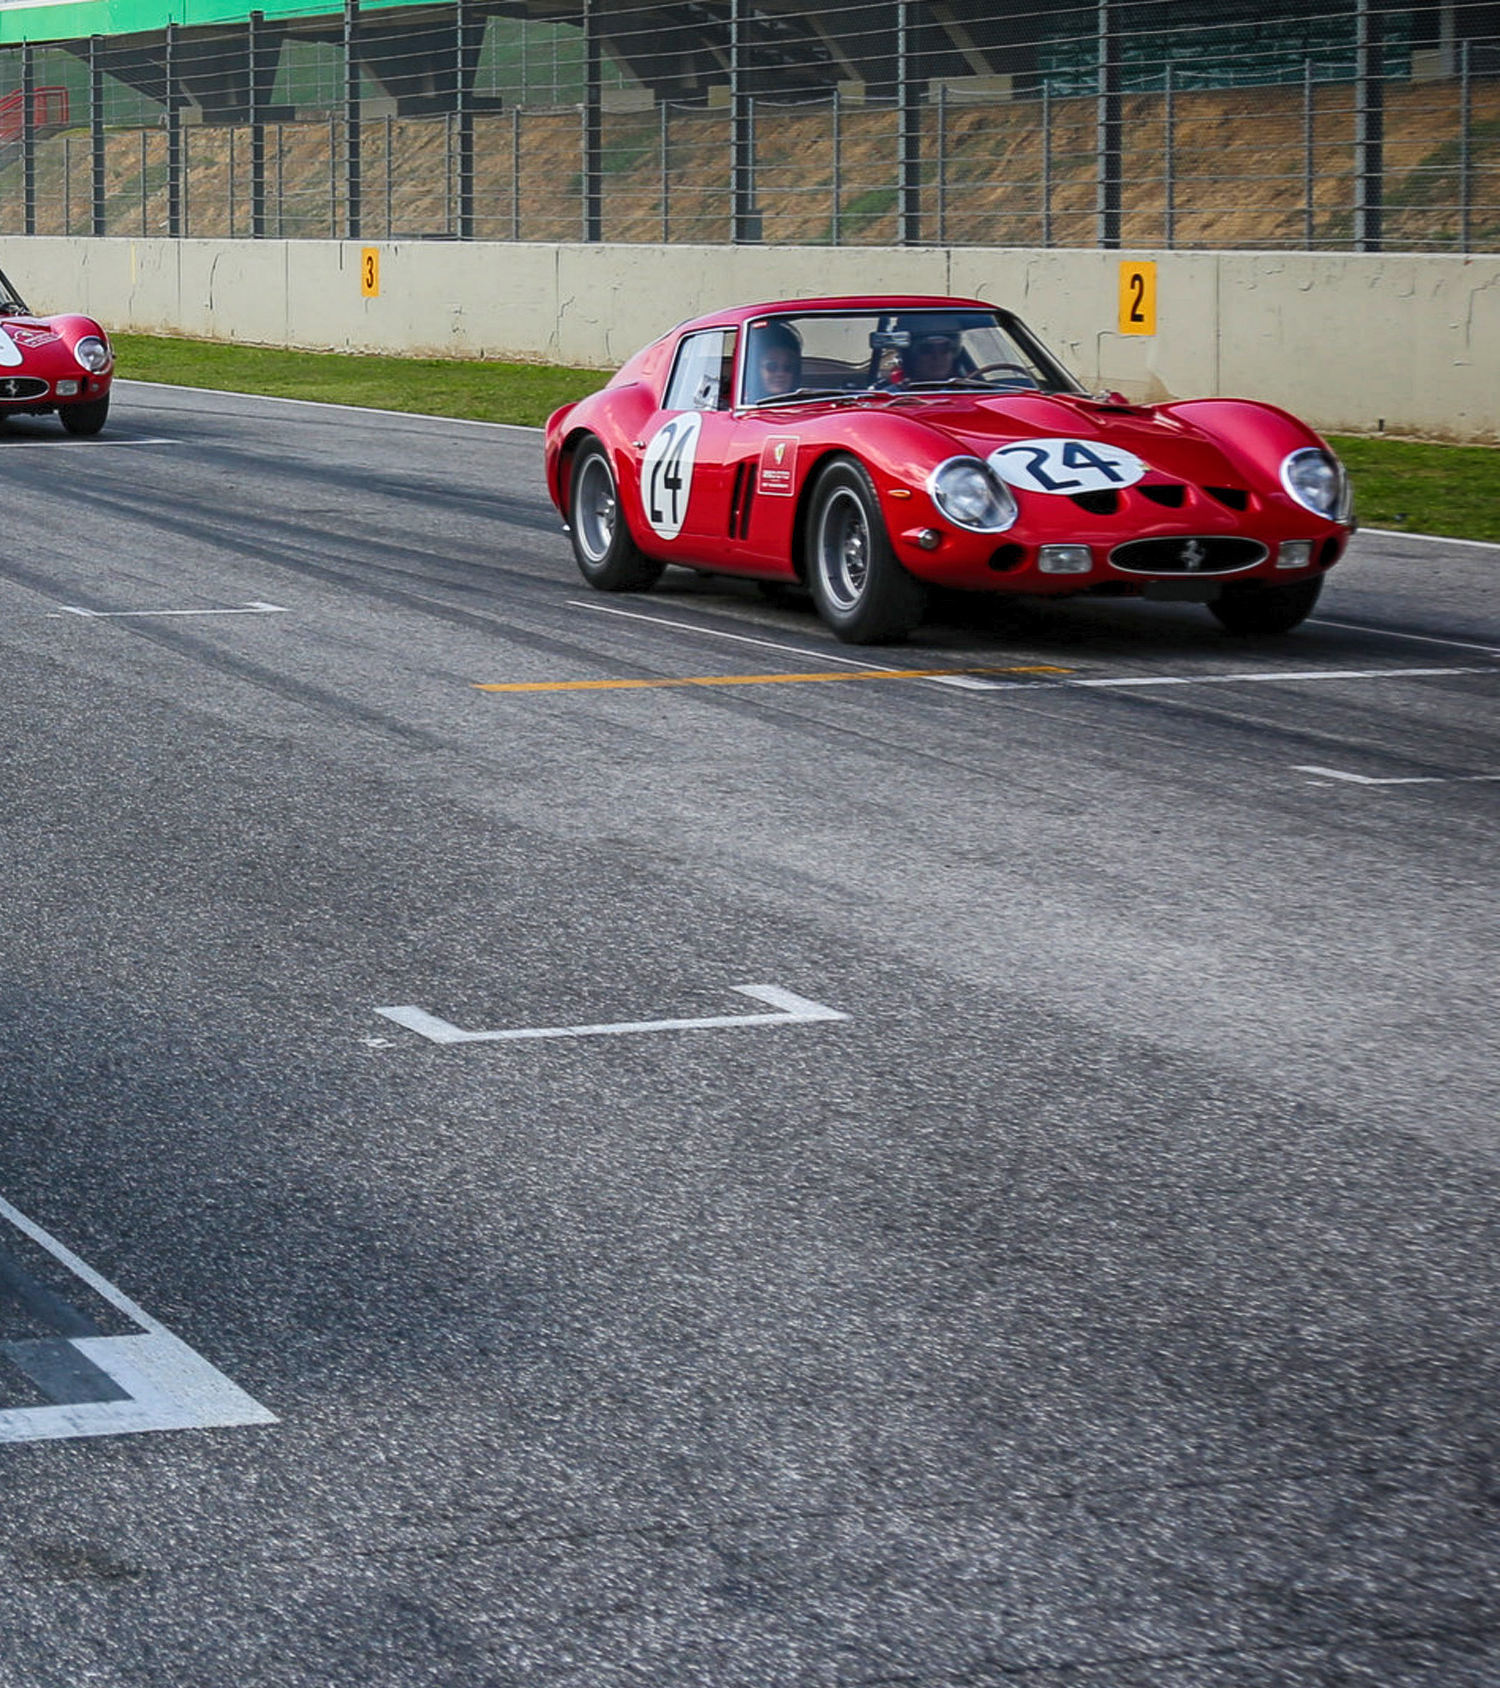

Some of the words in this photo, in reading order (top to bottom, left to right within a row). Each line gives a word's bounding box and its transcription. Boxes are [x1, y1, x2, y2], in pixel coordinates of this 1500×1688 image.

[365, 255, 374, 289] 3
[1130, 273, 1145, 323] 2
[650, 422, 696, 524] 24
[996, 441, 1126, 491] 24
